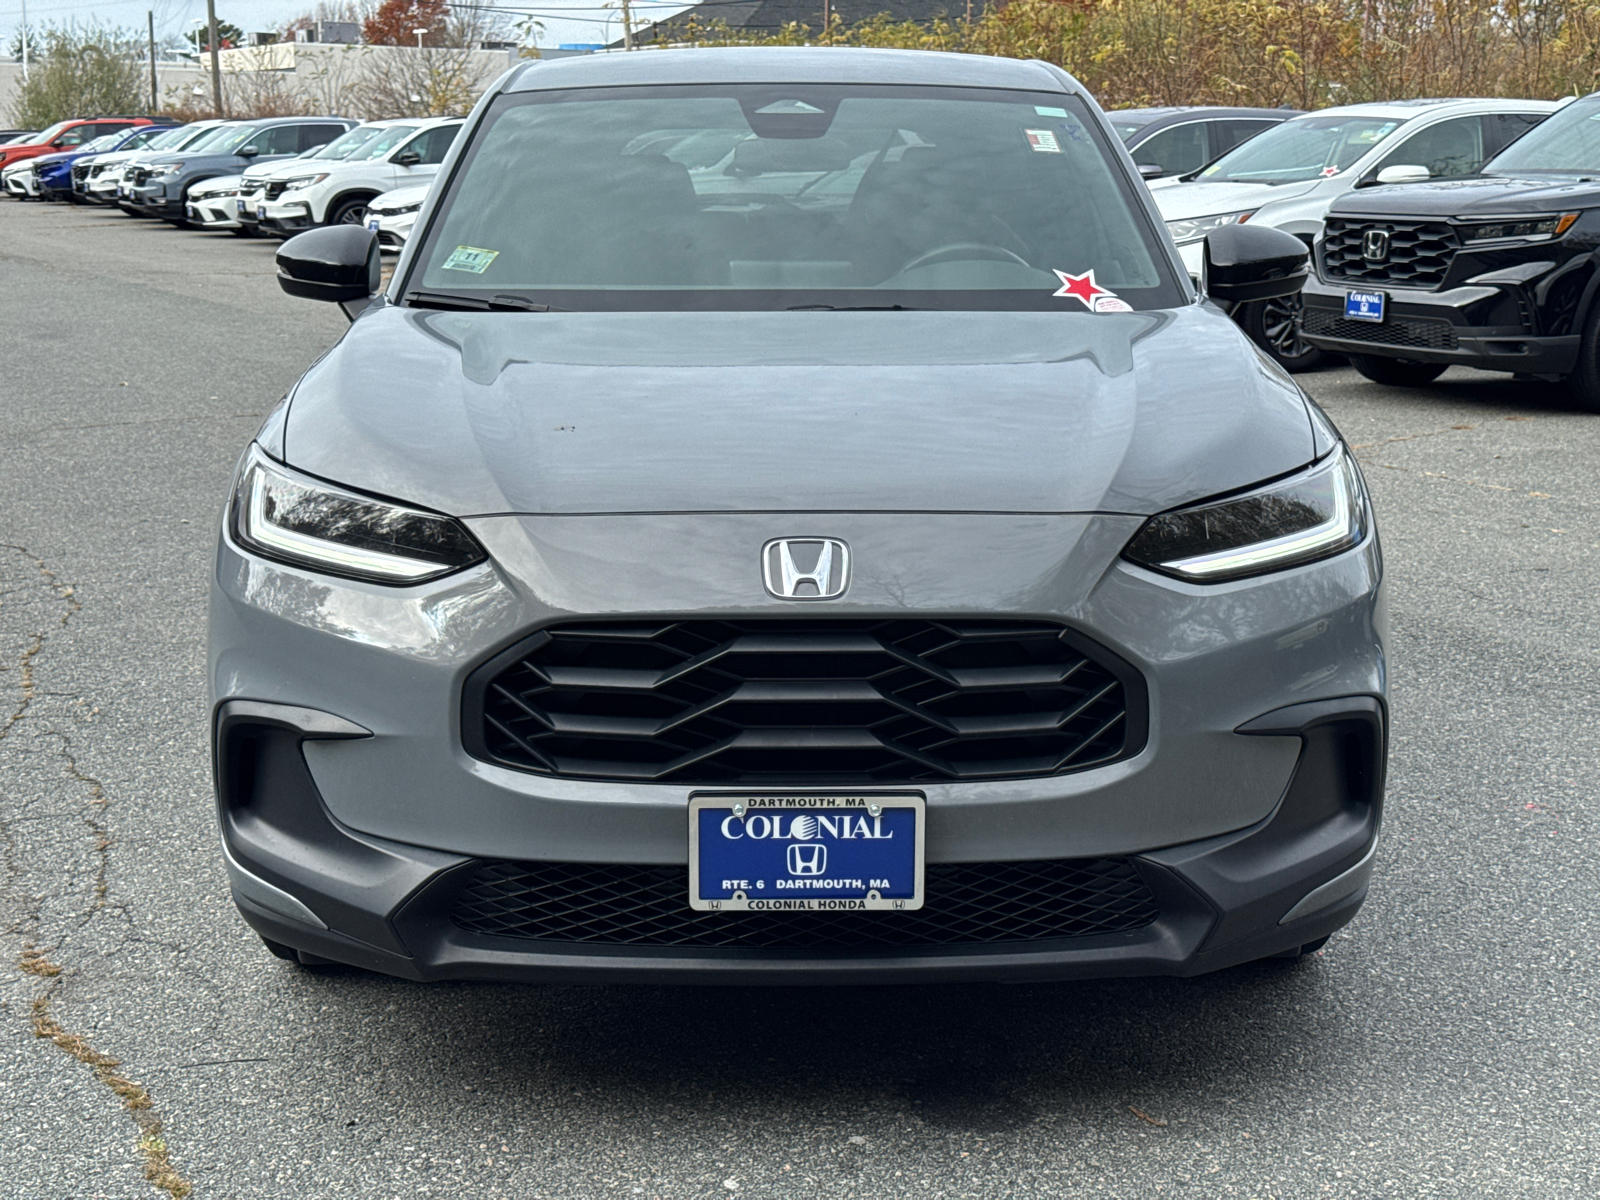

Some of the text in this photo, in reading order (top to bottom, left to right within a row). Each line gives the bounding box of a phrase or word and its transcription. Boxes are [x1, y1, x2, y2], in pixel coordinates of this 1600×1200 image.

[845, 798, 866, 807] MA
[720, 815, 894, 840] COLONIAL
[721, 879, 891, 890] RTE. 6 DARTMOUTH, MA
[747, 900, 867, 910] COLONIAL HONDA
